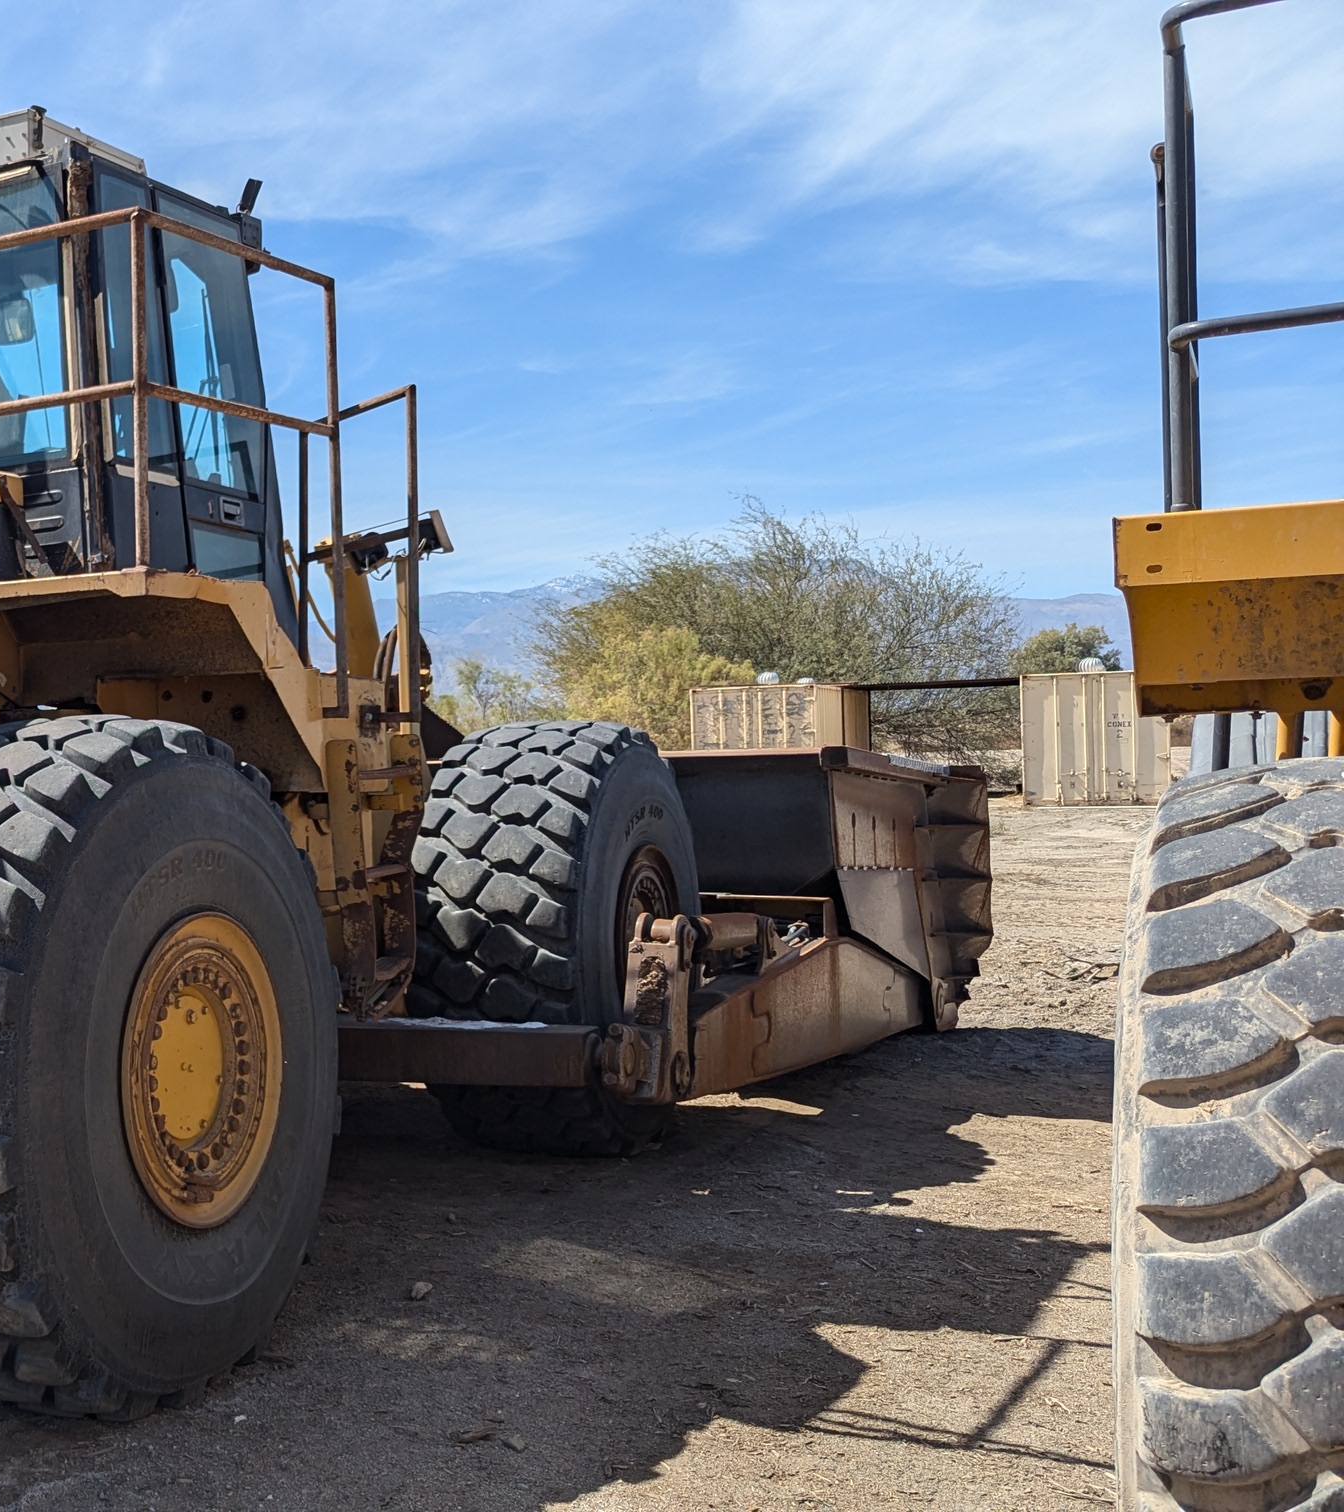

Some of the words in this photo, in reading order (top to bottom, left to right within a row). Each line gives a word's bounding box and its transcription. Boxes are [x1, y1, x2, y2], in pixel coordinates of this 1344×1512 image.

[1116, 729, 1123, 738] 2
[648, 804, 664, 820] 400
[192, 849, 228, 871] 400
